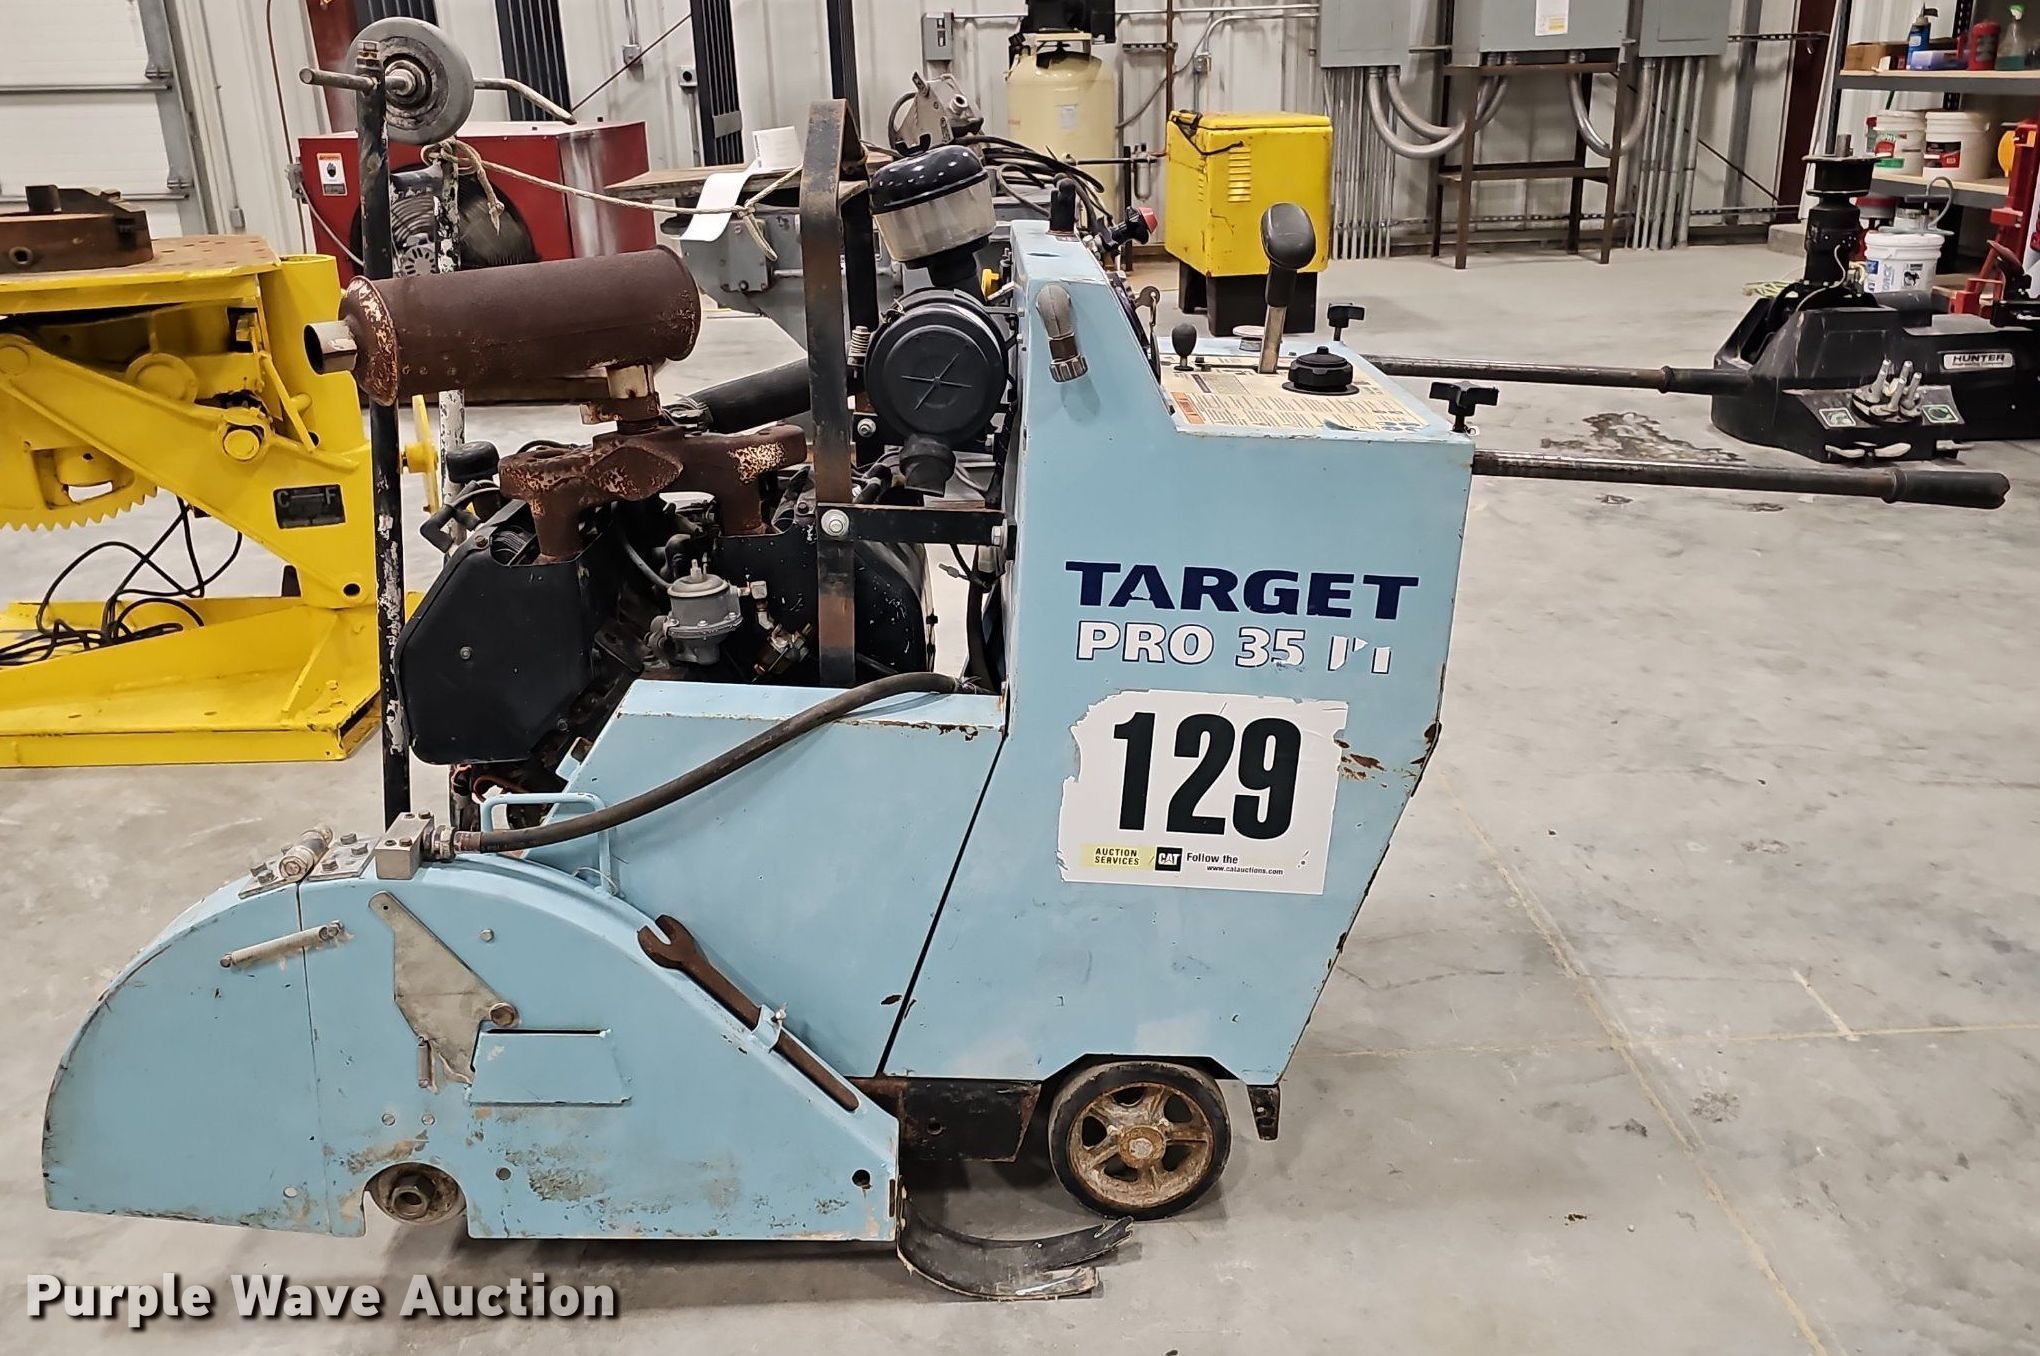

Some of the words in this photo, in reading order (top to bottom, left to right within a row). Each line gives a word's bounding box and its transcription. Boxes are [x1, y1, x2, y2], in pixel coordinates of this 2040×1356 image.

[1953, 353, 2005, 363] HUNTER
[1064, 560, 1420, 620] TARGET
[1075, 619, 1215, 665] PRO
[1234, 626, 1306, 668] 35
[1112, 711, 1302, 840] 129
[1095, 847, 1138, 857] AUCTION
[1158, 851, 1181, 866] CAT
[1186, 852, 1220, 863] Follow
[1222, 854, 1239, 864] the
[1094, 855, 1140, 866] SERVICES
